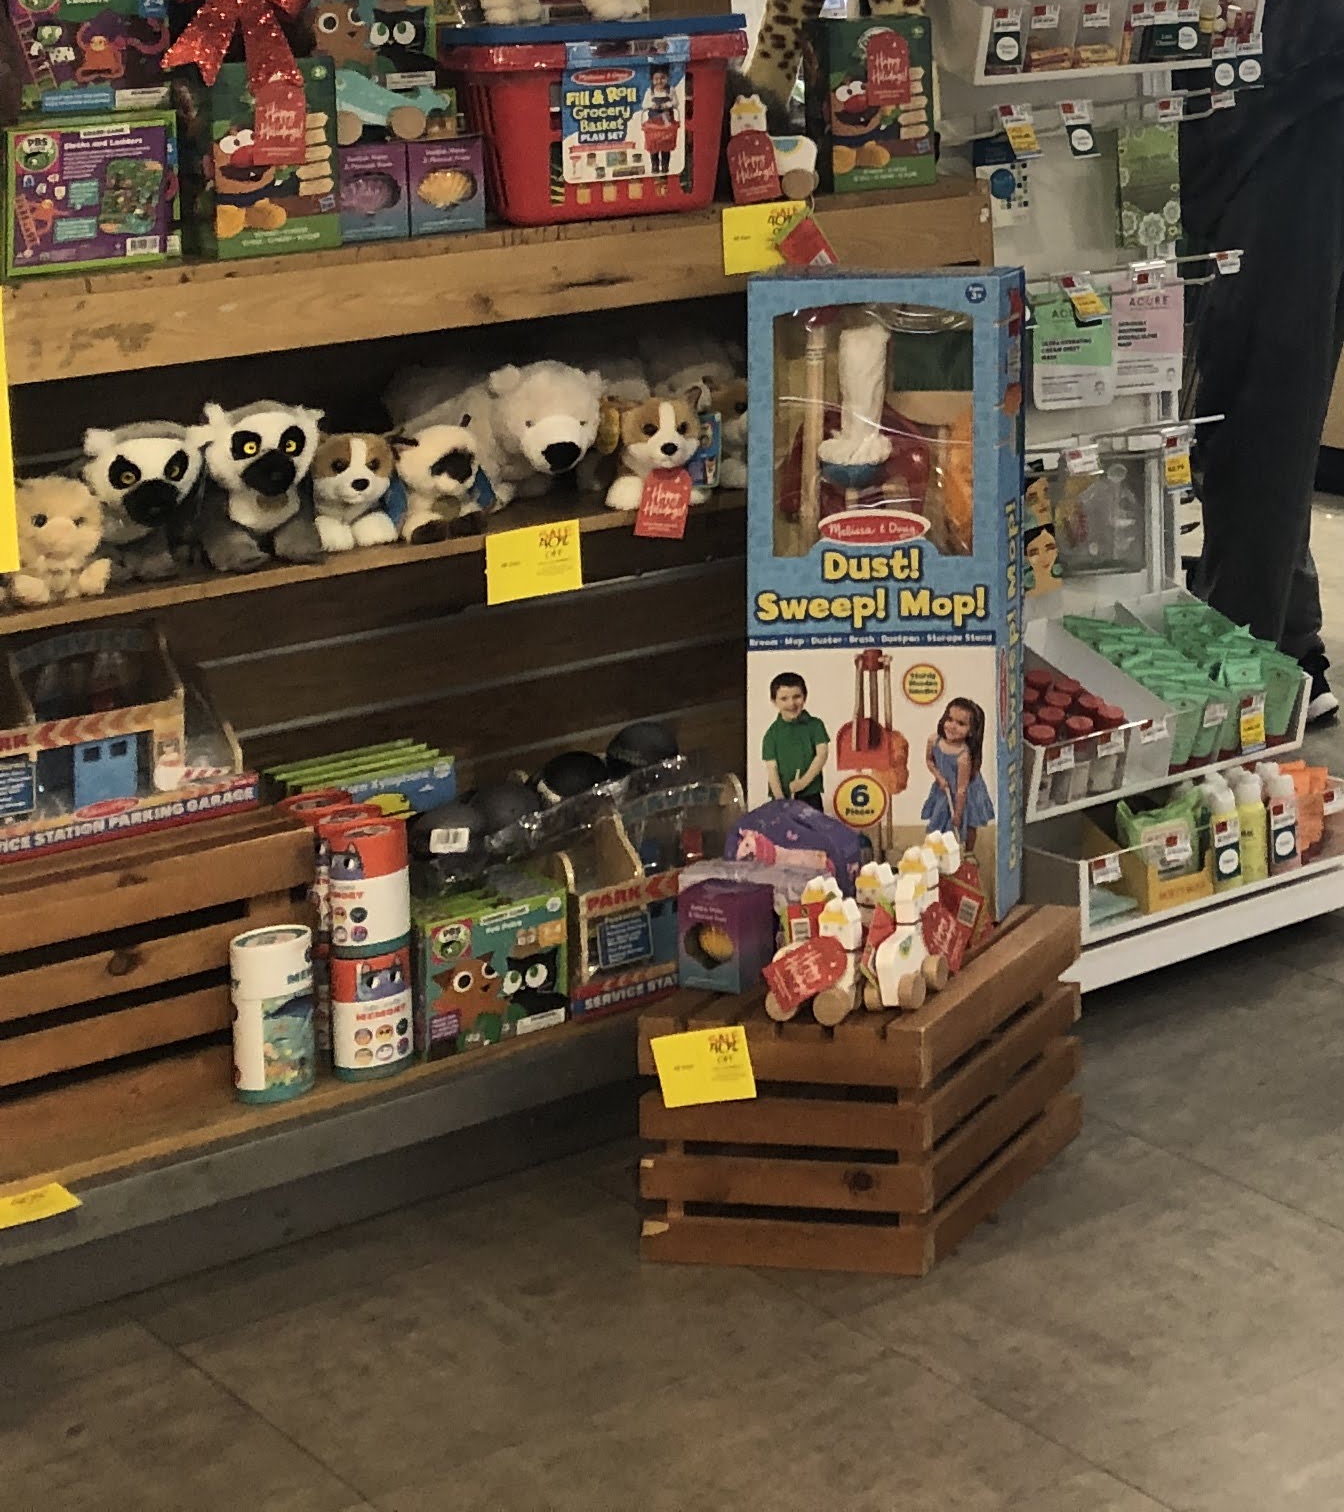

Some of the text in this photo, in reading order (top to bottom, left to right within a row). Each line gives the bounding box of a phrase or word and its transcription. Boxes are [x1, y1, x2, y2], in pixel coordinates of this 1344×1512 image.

[566, 87, 637, 106] Fill & Roll
[572, 106, 630, 120] Grocery
[580, 118, 625, 132] Basket
[580, 131, 624, 142] PLAY SET
[1129, 295, 1170, 307] ACURE
[822, 548, 920, 581] Dust!
[756, 586, 987, 629] Sweep! Mop!
[850, 784, 870, 807] 6
[34, 787, 255, 847] STATION PARKING GARAGE
[587, 885, 640, 912] PARK
[584, 982, 645, 1011] SERVICE
